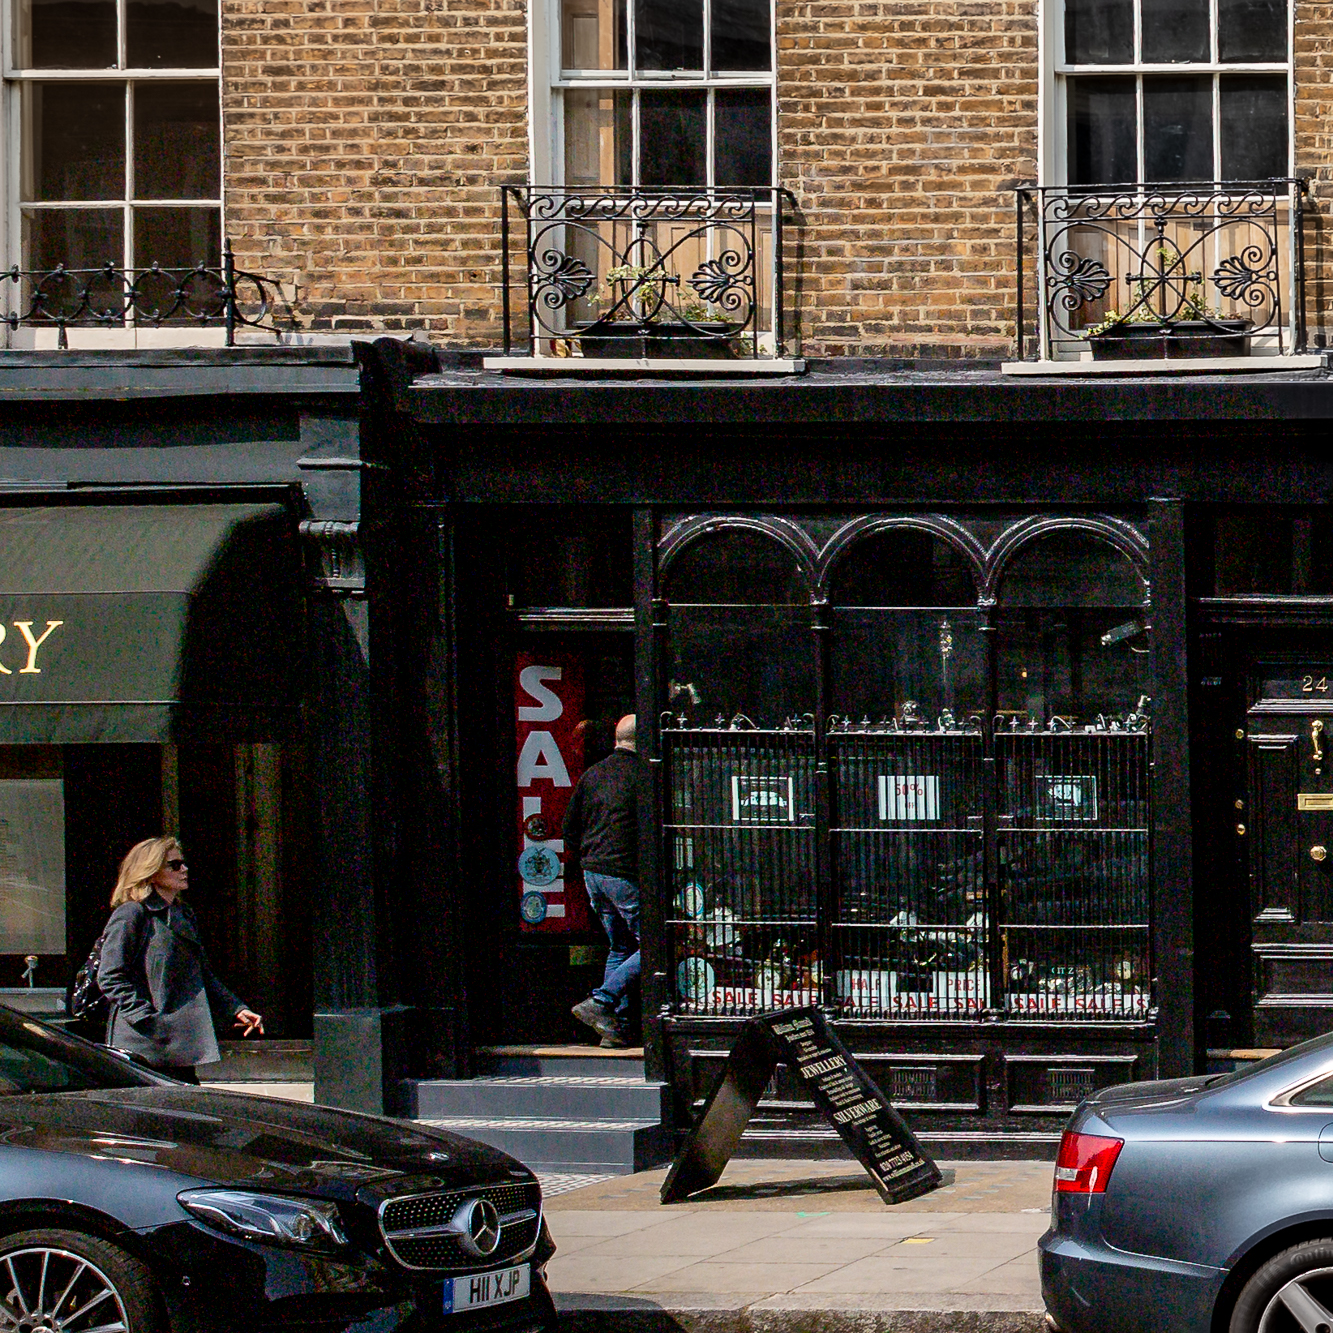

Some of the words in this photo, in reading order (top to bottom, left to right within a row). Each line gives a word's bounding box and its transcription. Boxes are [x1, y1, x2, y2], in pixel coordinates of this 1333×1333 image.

[1302, 675, 1329, 692] 24
[711, 990, 759, 1005] SALE
[800, 1055, 847, 1079] JEWELLERY
[833, 1098, 882, 1125] SILVERWARE
[494, 1269, 519, 1299] XJP
